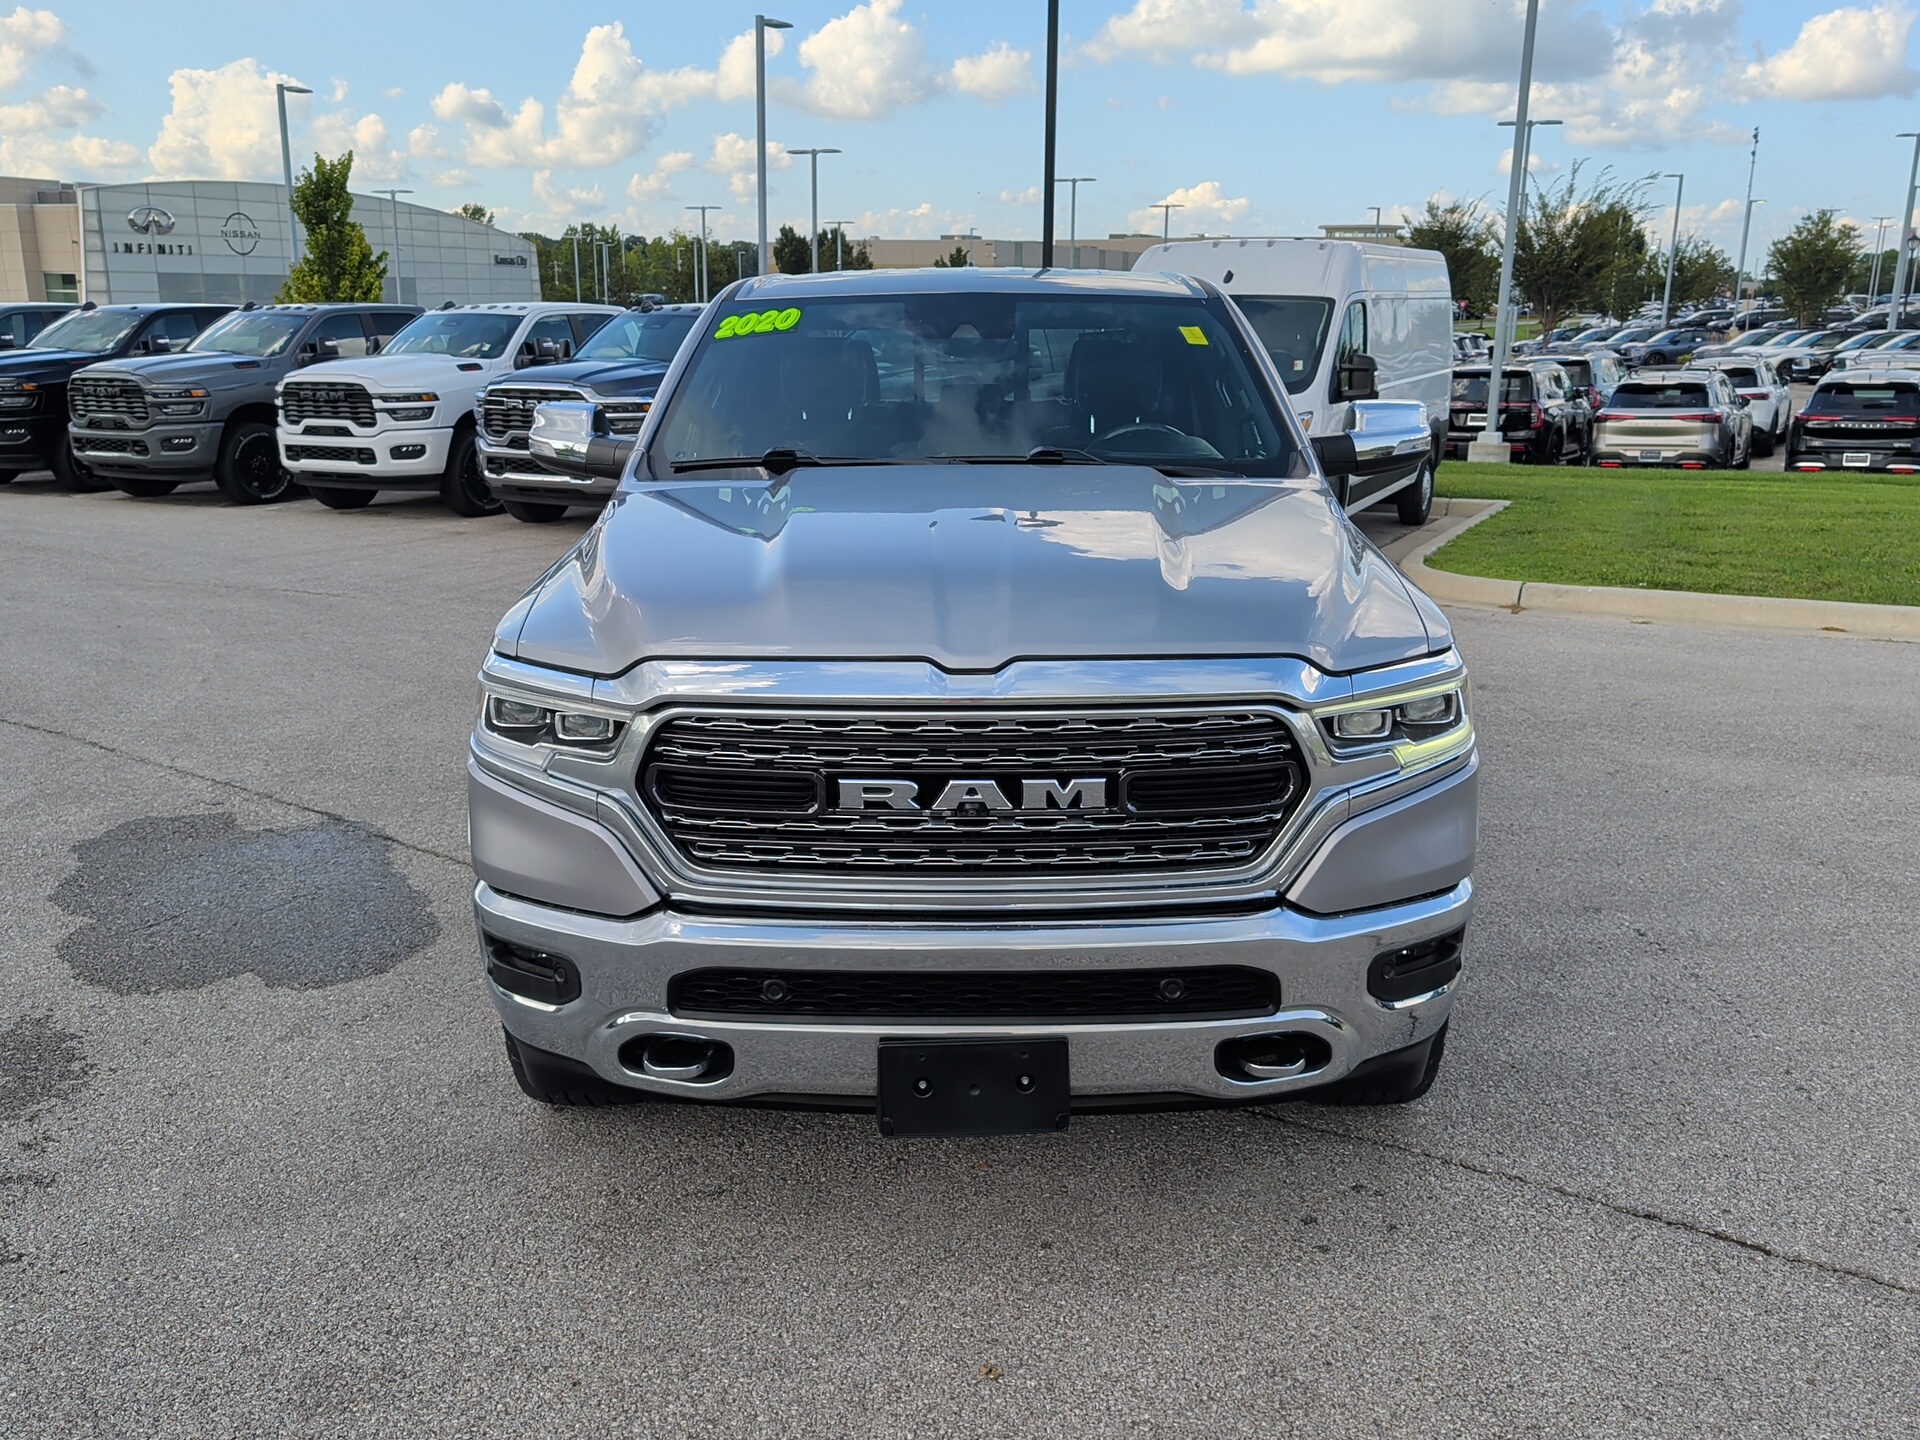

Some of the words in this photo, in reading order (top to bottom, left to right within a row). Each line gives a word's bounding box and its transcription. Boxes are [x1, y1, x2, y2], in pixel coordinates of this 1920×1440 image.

[221, 229, 261, 239] NISSAN
[113, 242, 193, 256] INFINITI
[494, 254, 516, 266] Kansas
[516, 255, 528, 269] City
[714, 307, 802, 340] 2020
[83, 386, 121, 396] RAM
[299, 388, 346, 401] RAM
[506, 399, 550, 410] RA
[838, 778, 1107, 810] RAM
